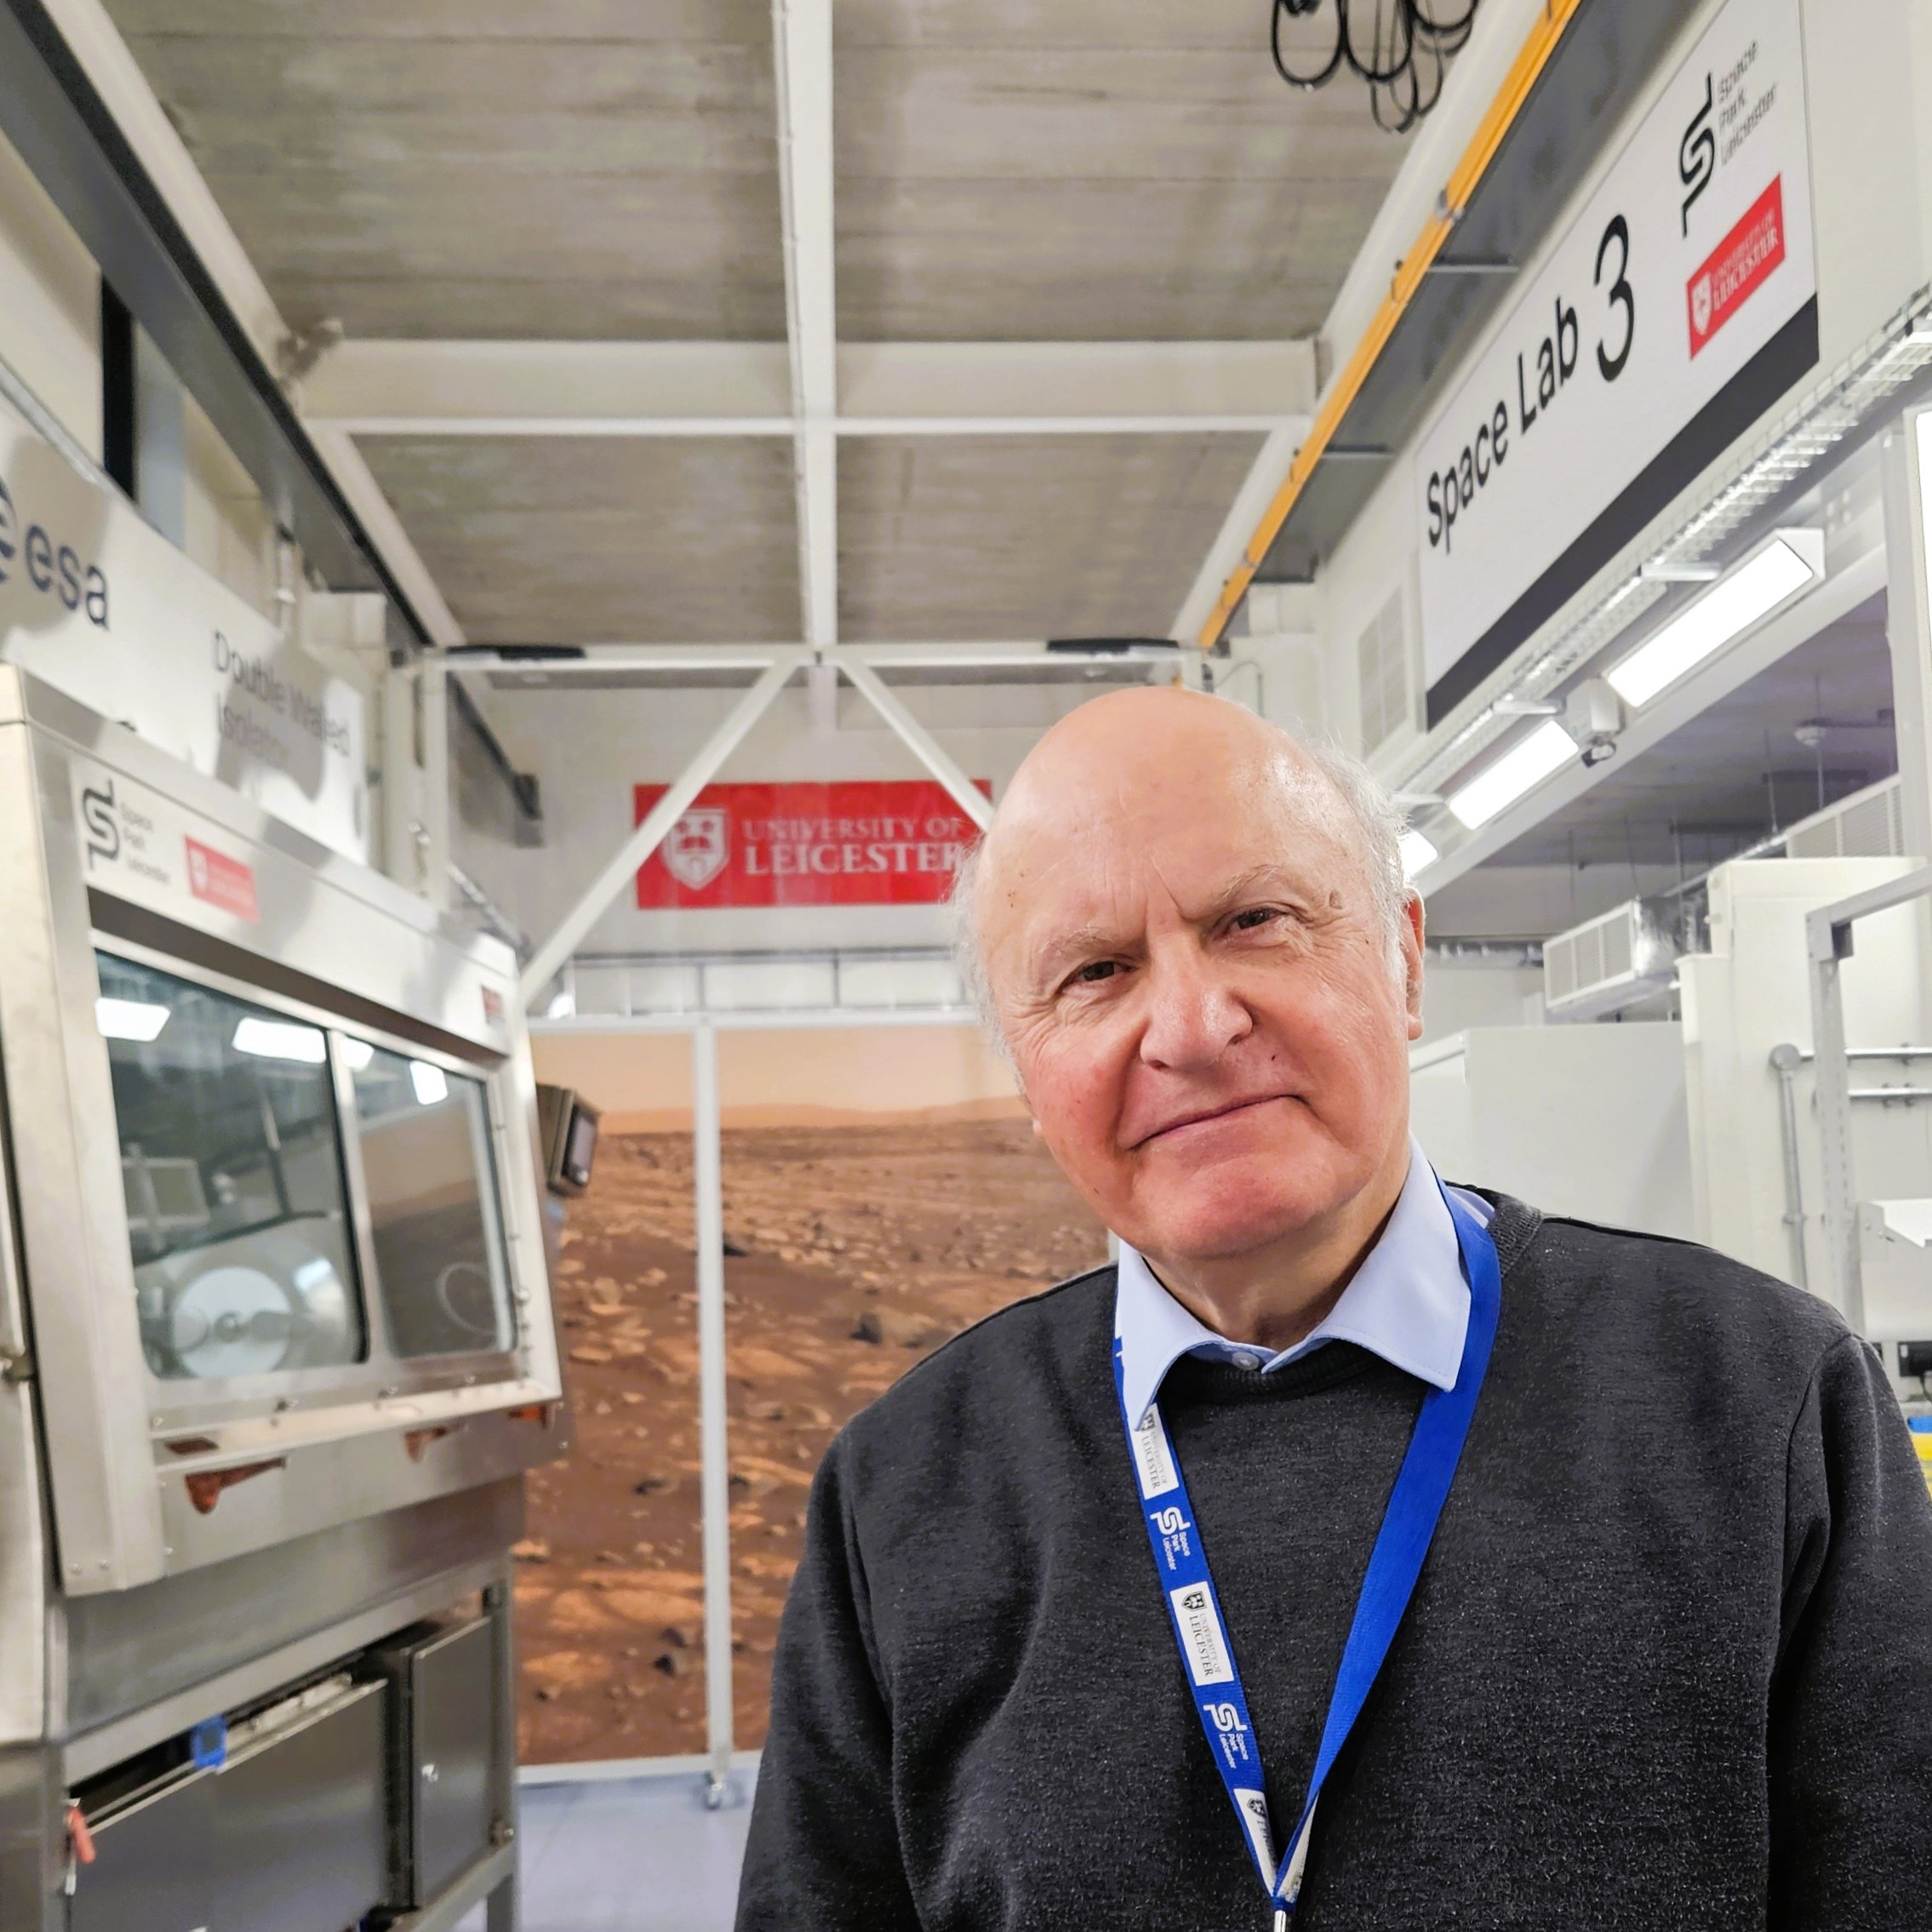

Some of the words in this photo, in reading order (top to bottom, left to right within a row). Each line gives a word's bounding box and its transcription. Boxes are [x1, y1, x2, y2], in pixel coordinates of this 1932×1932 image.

[1426, 399, 1509, 555] Space
[1517, 293, 1579, 437] Lab
[1593, 213, 1635, 383] 3
[24, 523, 111, 632] esa
[742, 815, 919, 841] UNIVERSITY
[925, 815, 961, 838] OF
[1140, 1436, 1161, 1489] LEICESTER
[1189, 1615, 1214, 1677] LEICESTER
